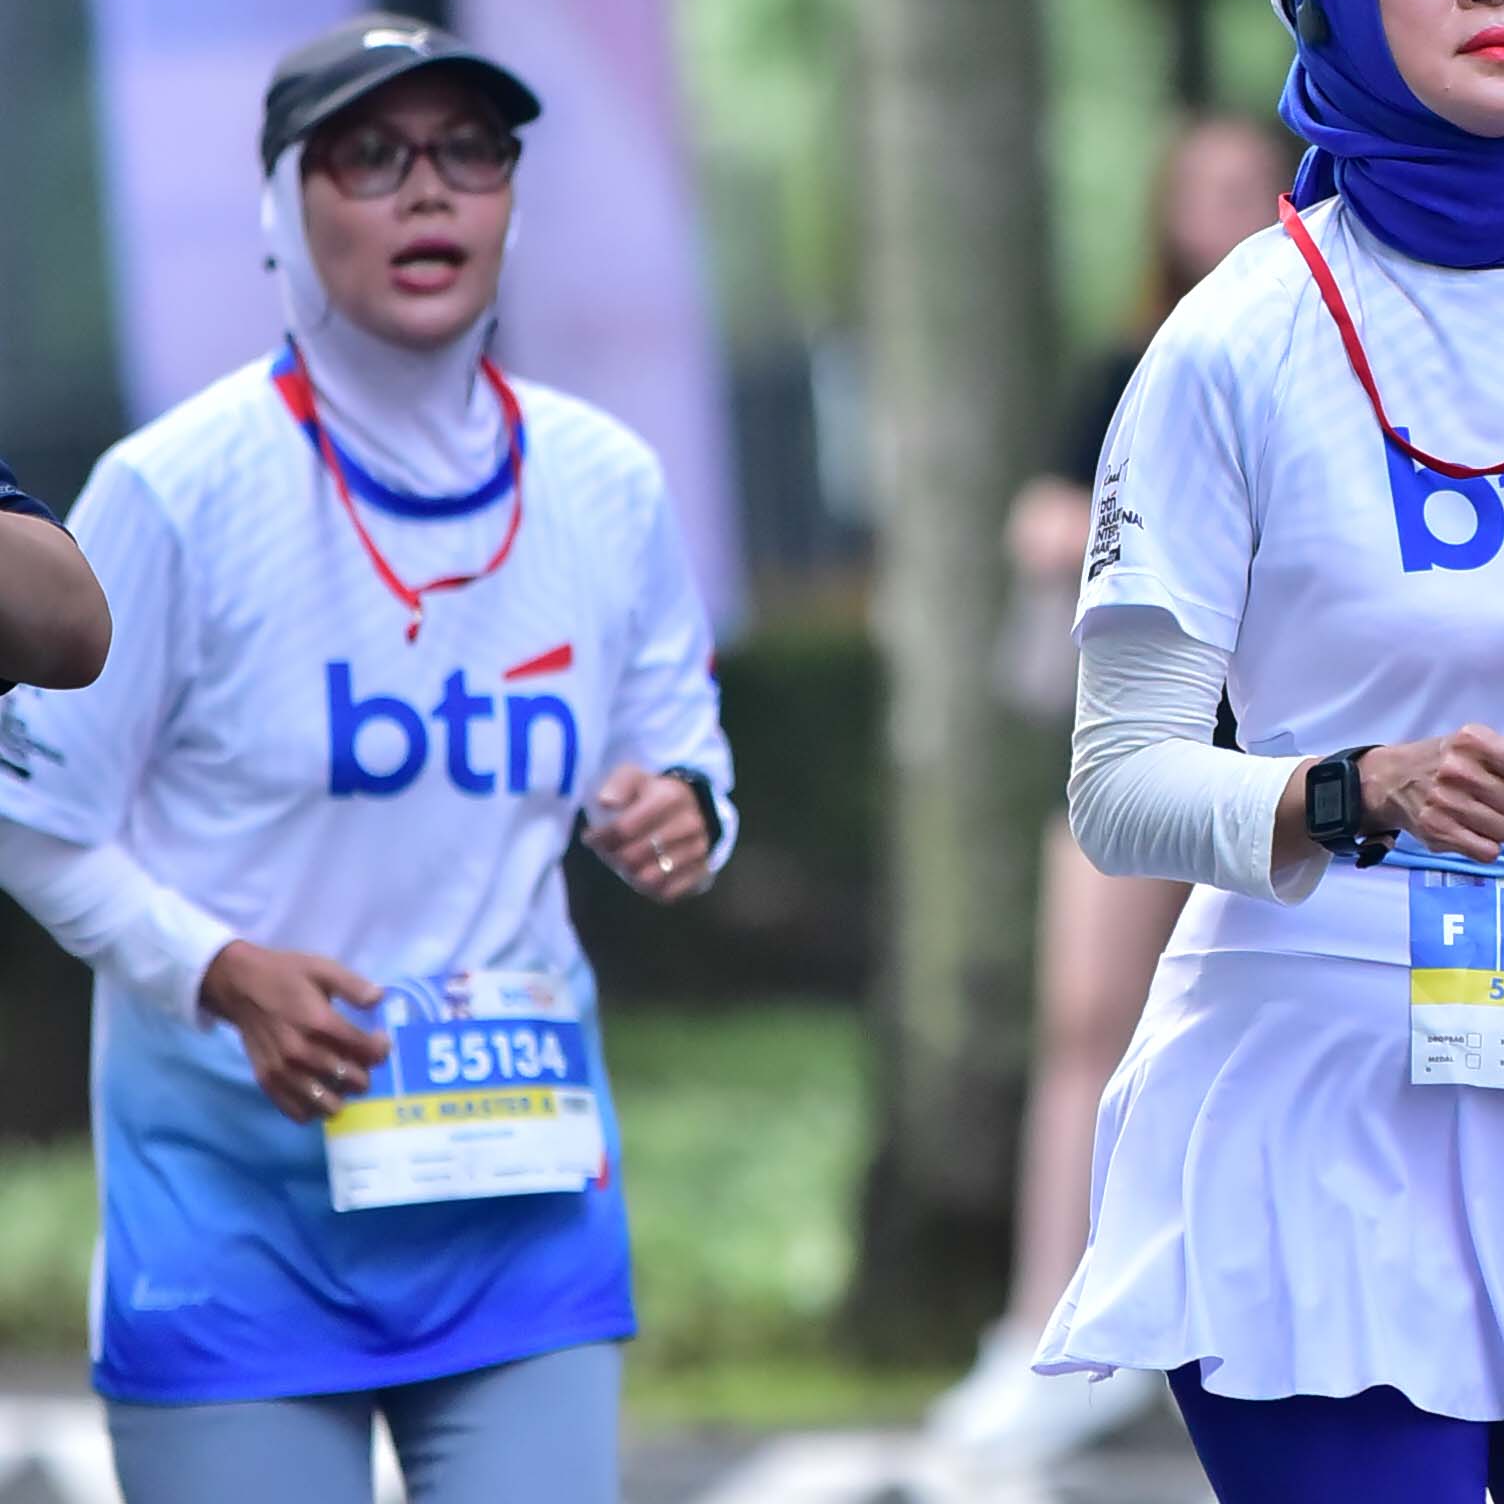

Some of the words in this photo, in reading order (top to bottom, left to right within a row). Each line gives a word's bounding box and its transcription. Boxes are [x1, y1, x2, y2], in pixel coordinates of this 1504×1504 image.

[325, 642, 579, 796] btn
[1442, 913, 1466, 946] F
[426, 1027, 568, 1085] 55134
